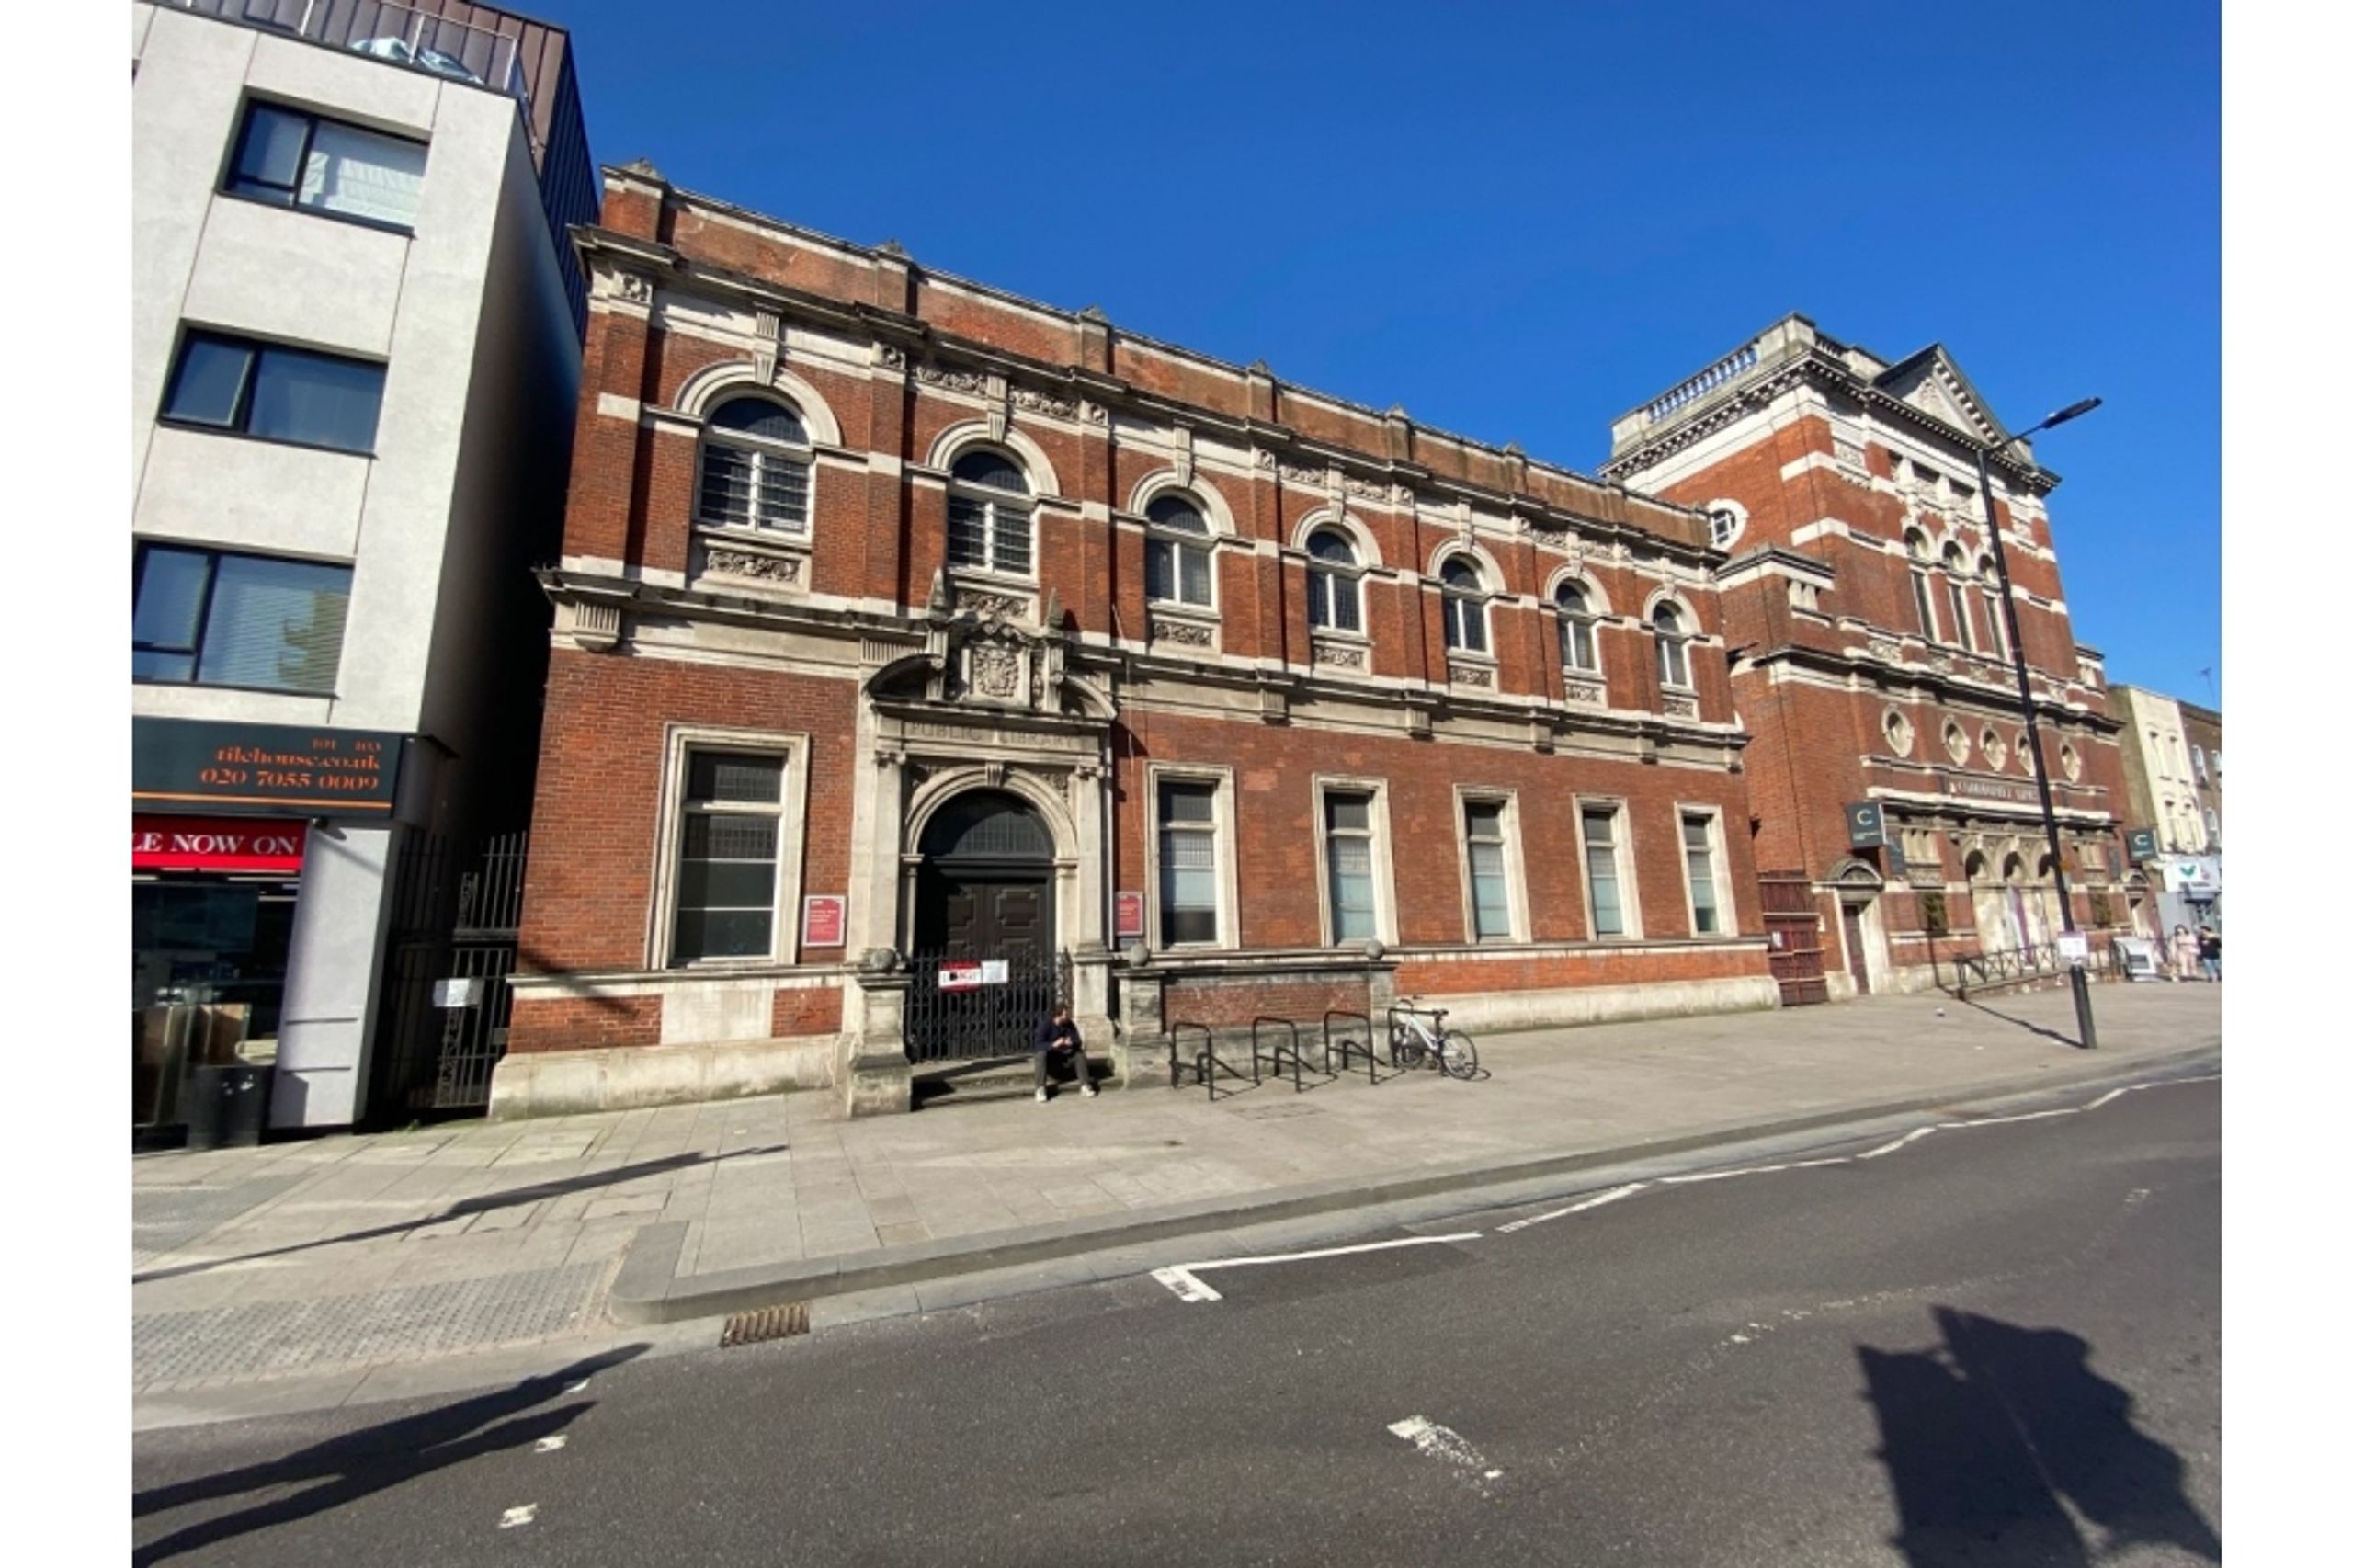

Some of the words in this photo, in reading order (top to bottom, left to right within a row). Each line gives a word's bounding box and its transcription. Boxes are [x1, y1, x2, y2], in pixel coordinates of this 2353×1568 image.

[216, 746, 381, 769] tilehouse.co.uk
[199, 768, 247, 785] 020
[256, 770, 312, 788] 7055
[169, 834, 245, 854] NOW
[252, 835, 299, 855] ON
